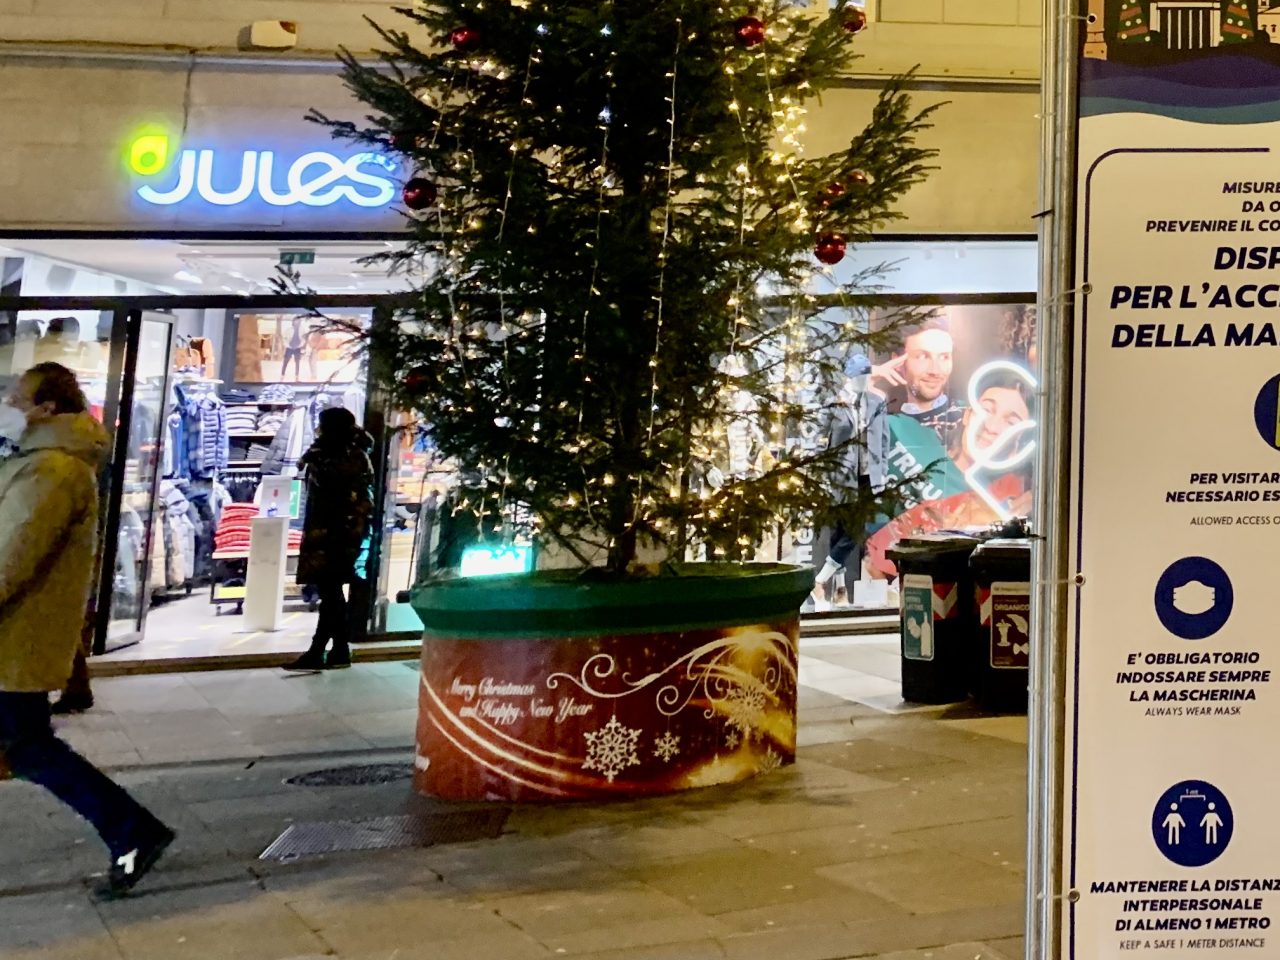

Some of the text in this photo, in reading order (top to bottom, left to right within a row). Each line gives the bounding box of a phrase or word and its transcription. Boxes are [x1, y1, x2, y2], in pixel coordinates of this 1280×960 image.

[1242, 201, 1265, 212] DA
[1146, 220, 1238, 232] PREVENIRE
[1240, 220, 1254, 232] IL
[1110, 285, 1173, 309] PER
[1111, 323, 1216, 348] DELLA
[1190, 473, 1218, 484] PER
[1166, 490, 1260, 502] NECESSARIO
[1190, 516, 1233, 525] ALLOWED
[1236, 516, 1270, 525] ACCESS
[1127, 652, 1259, 665] E' OBBLIGATORIO
[1116, 670, 1271, 683] INDOSSARE SEMPRE
[479, 677, 536, 696] Christmas
[1130, 689, 1256, 702] LA MASCHERINA
[460, 697, 593, 725] and Happy New Year
[1145, 707, 1240, 716] ALWAYS WEAR MASK
[1090, 880, 1188, 893] MANTENERE
[1191, 880, 1211, 892] LA
[1123, 898, 1263, 912] INTERPERSONALE
[1115, 917, 1270, 931] DI ALMENO 1 METRO
[1120, 940, 1141, 949] KEEP
[1154, 940, 1175, 949] SAFE
[1180, 939, 1183, 948] 1
[1187, 939, 1216, 948] METER
[1219, 938, 1264, 948] DISTANCE
